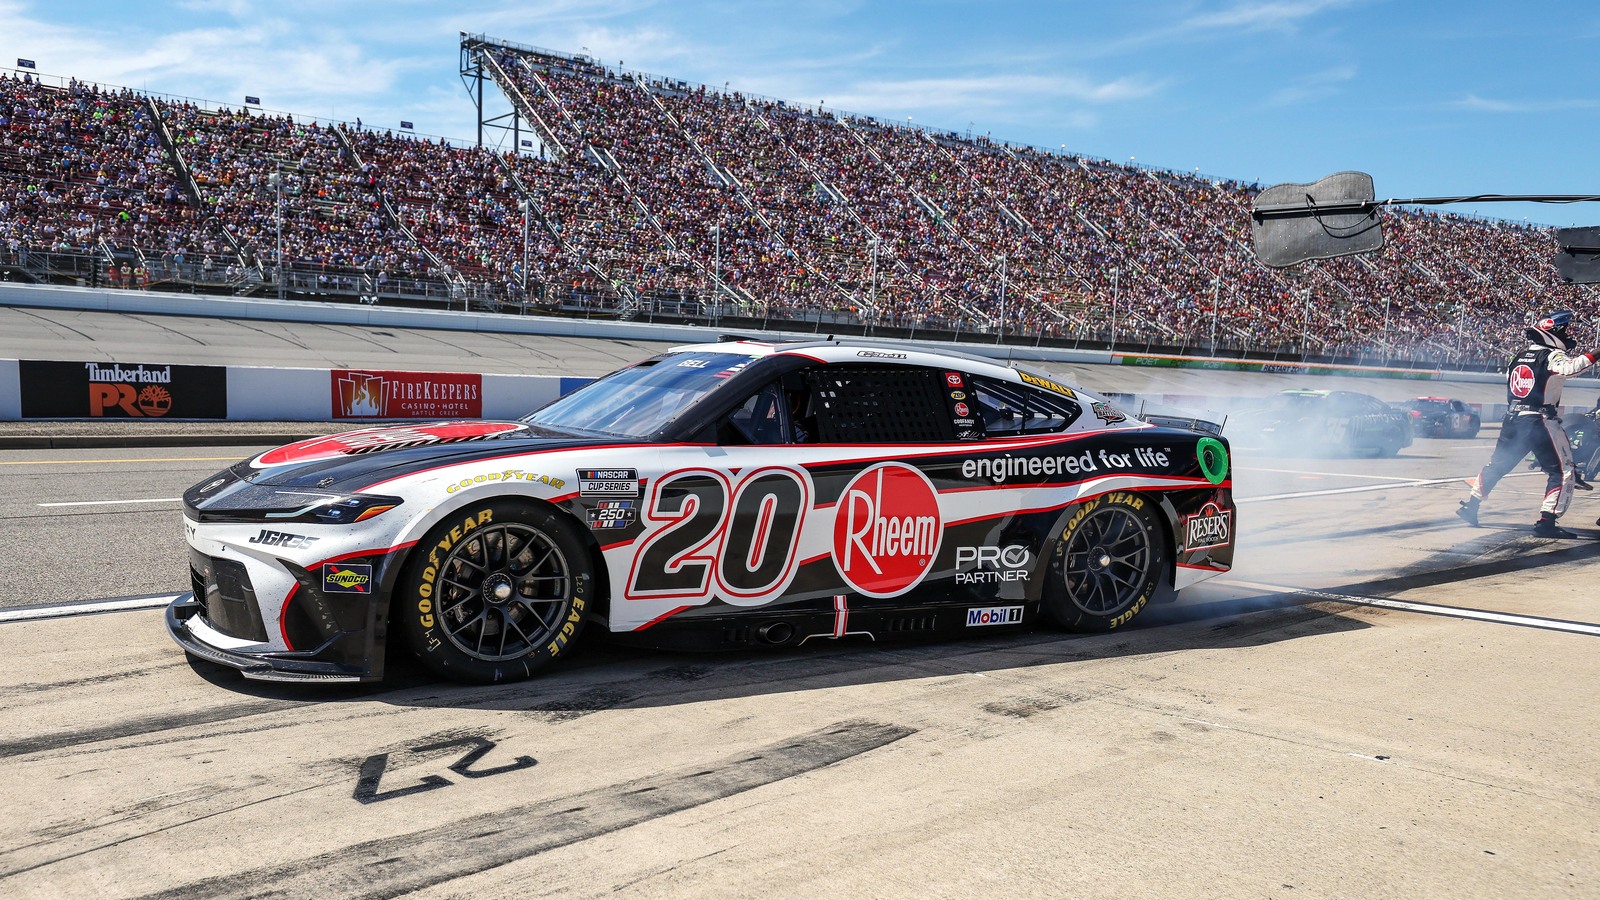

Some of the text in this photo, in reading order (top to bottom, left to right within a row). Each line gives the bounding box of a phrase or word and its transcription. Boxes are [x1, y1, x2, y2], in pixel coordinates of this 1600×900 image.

[85, 362, 171, 383] Timberland
[1135, 357, 1159, 366] POET
[401, 402, 436, 410] CASINO
[597, 471, 629, 479] NASCAR
[961, 450, 1097, 483] engineered
[1099, 449, 1132, 469] for
[446, 469, 566, 494] GOODYEAR
[588, 482, 631, 490] CUP SERIES
[598, 508, 625, 520] 250
[843, 467, 937, 575] Rheem
[624, 466, 809, 600] 20
[418, 508, 494, 628] GOODYEAR
[955, 544, 1030, 570] PRO
[327, 574, 367, 584] SUNOCO
[968, 608, 1007, 625] Mobil
[1109, 594, 1147, 629] EAGLE
[548, 596, 585, 657] EAGLE
